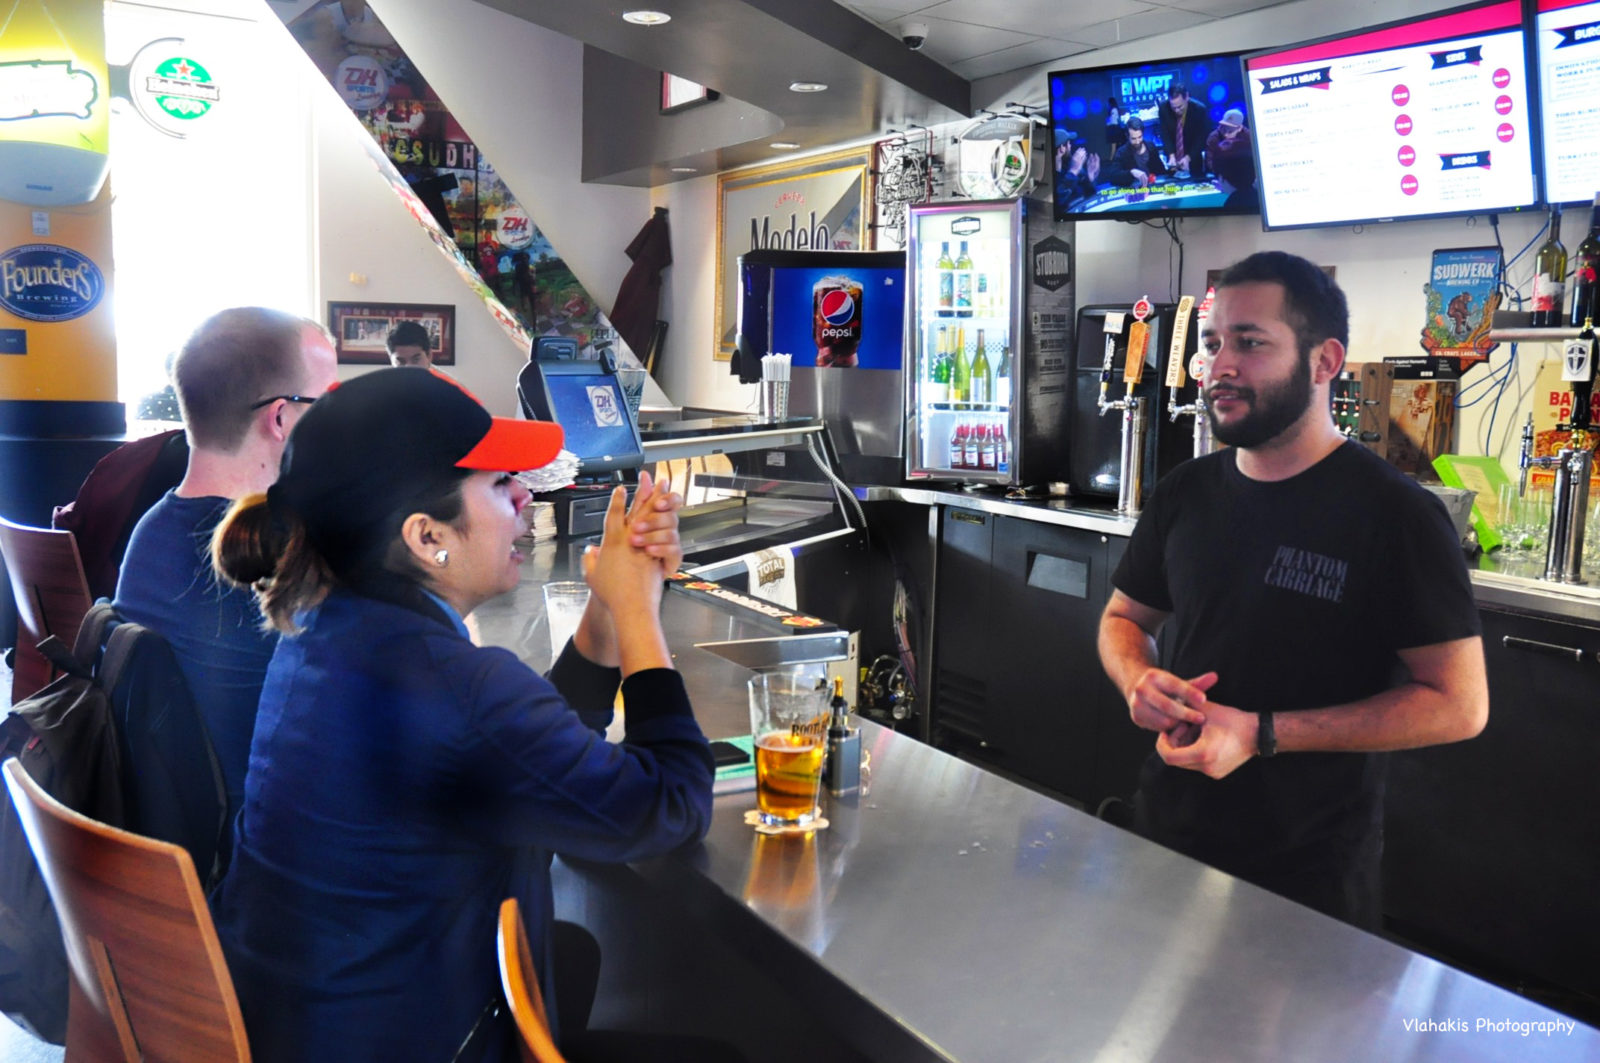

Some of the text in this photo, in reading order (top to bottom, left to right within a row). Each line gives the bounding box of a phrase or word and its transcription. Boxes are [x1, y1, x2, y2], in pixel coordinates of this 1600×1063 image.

[344, 67, 378, 86] DH
[1133, 74, 1173, 95] WPT
[1270, 77, 1292, 89] SALADS
[1299, 72, 1321, 84] WRAPS
[502, 217, 529, 231] DH
[750, 211, 829, 250] Modelo
[2, 258, 92, 301] Founders
[1434, 262, 1496, 280] SUDWERK
[16, 294, 78, 303] Brewing
[822, 327, 853, 339] pepsi
[1176, 315, 1185, 340] THREE
[1169, 345, 1181, 383] WEAVERS
[594, 395, 612, 407] DH
[757, 557, 785, 577] TOTAL
[1272, 545, 1349, 583] PHANTOM
[1263, 566, 1344, 604] CARRIAGE
